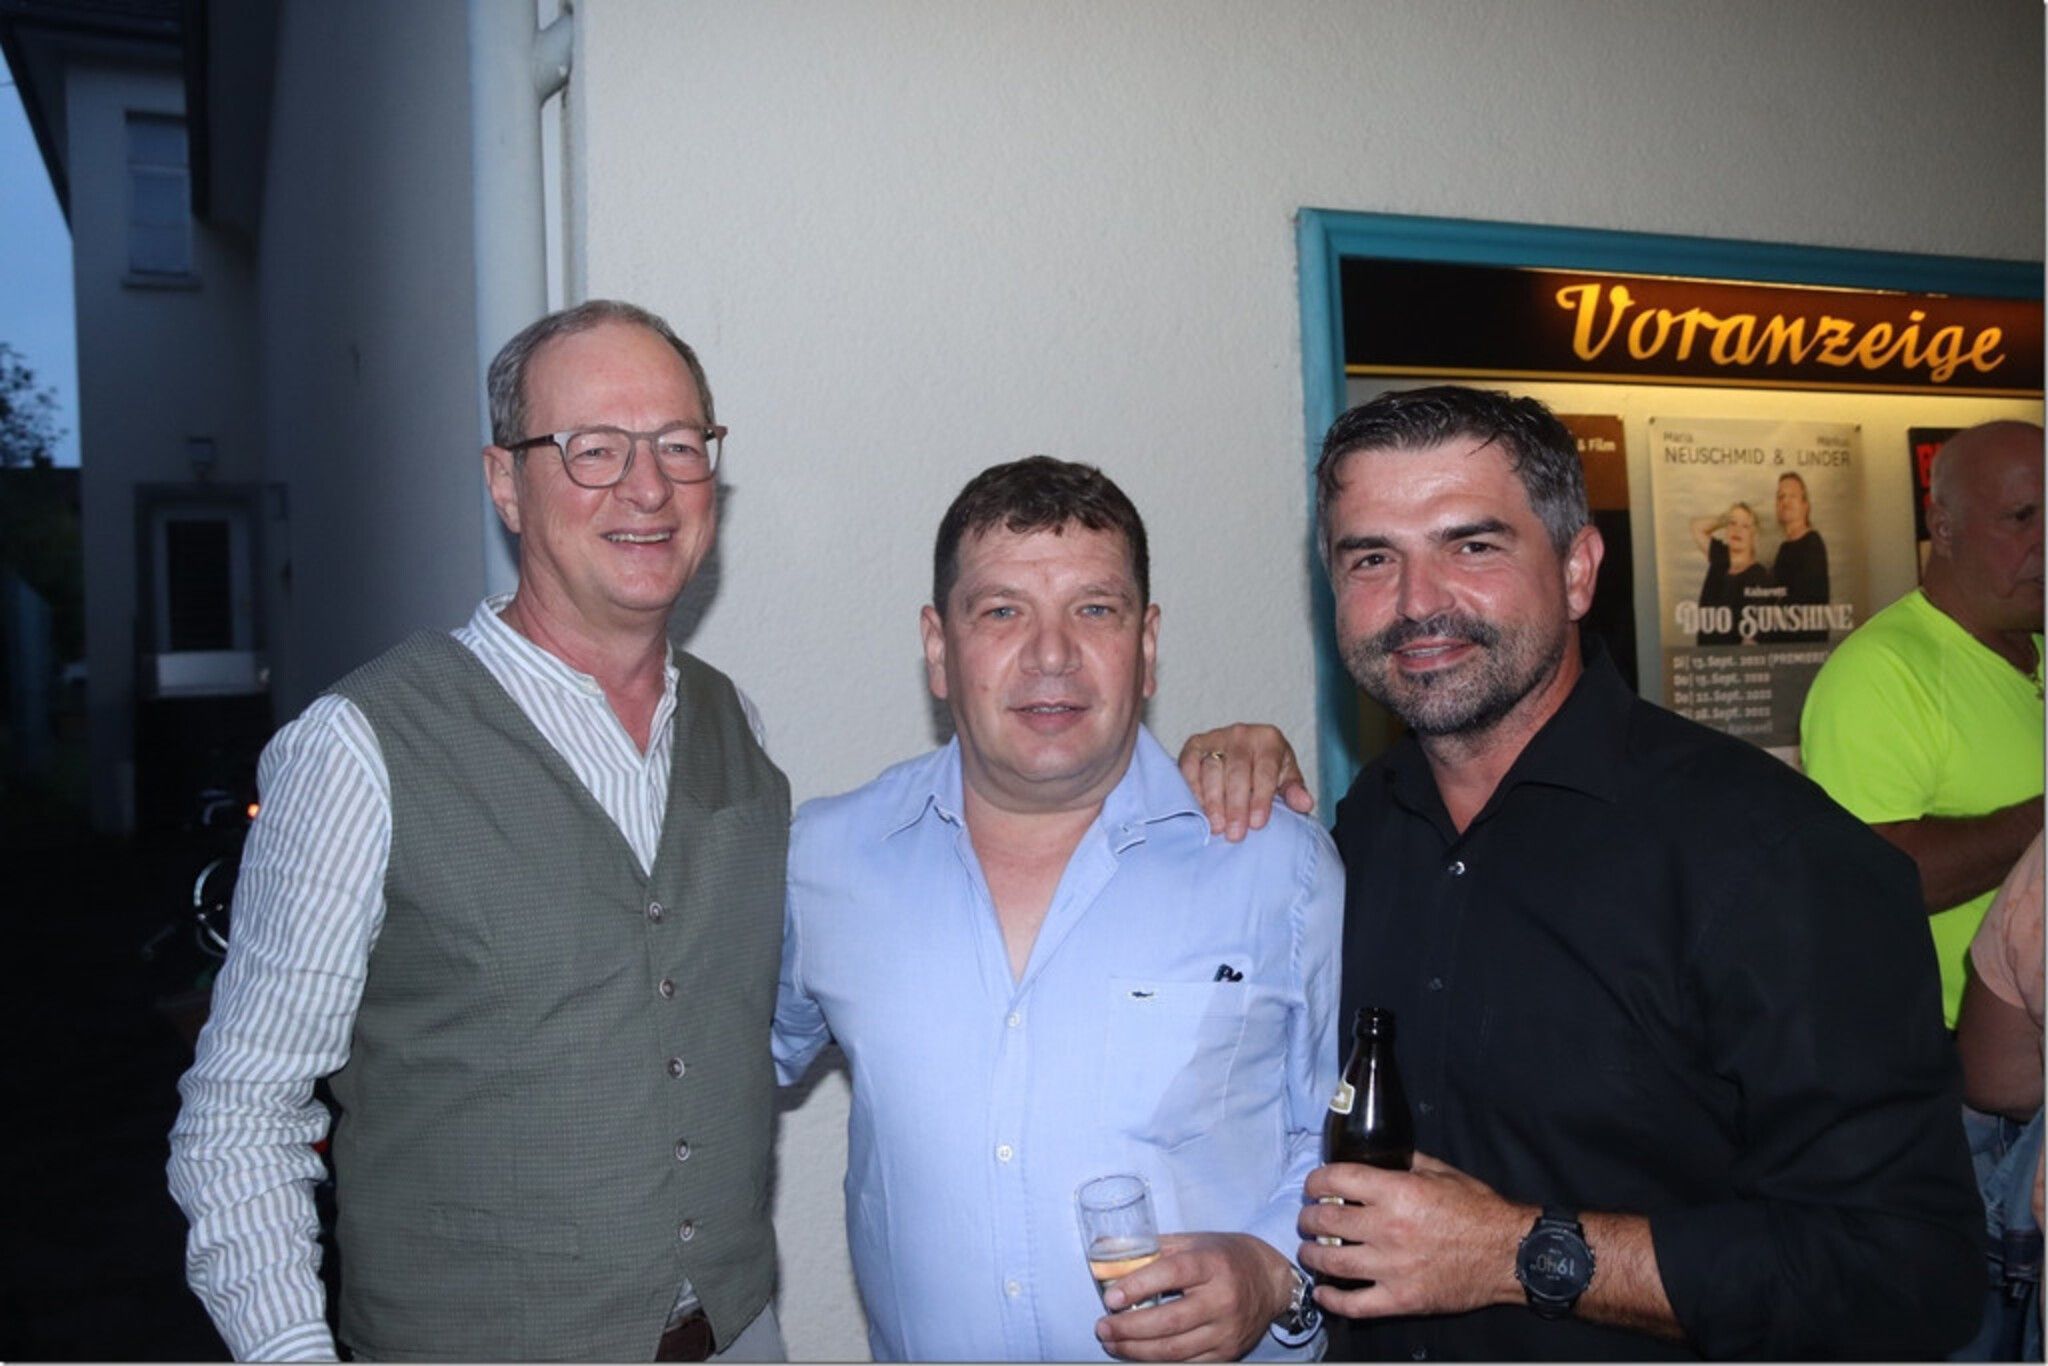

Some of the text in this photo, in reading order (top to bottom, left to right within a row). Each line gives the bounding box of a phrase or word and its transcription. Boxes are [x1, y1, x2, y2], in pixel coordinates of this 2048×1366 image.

[1556, 283, 2005, 383] Voranzeige
[1665, 447, 1850, 468] NEUSCHMID & LINDER
[1675, 600, 1855, 638] DUO SUNSHINE
